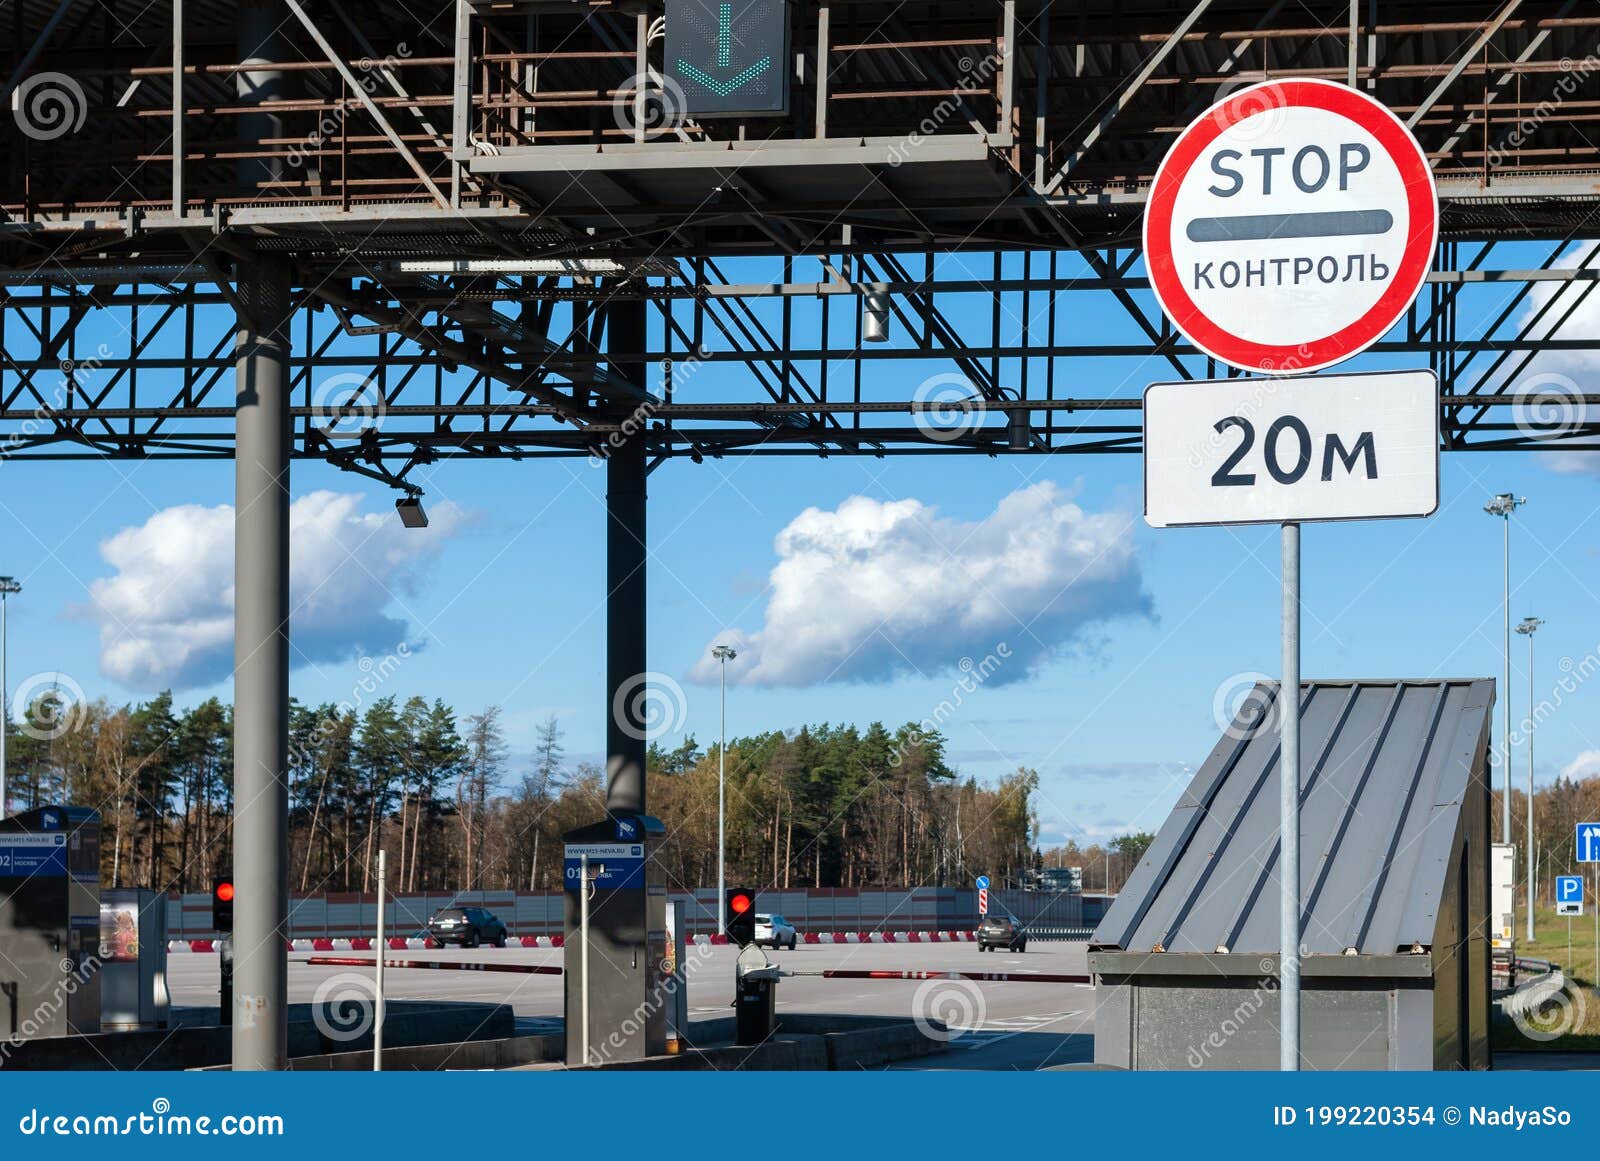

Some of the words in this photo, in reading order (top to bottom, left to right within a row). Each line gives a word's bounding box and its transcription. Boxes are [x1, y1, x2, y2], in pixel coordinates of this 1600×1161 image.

[1208, 142, 1371, 198] STOP
[1194, 253, 1390, 290] КОНТРОЛЬ
[1563, 879, 1578, 900] P
